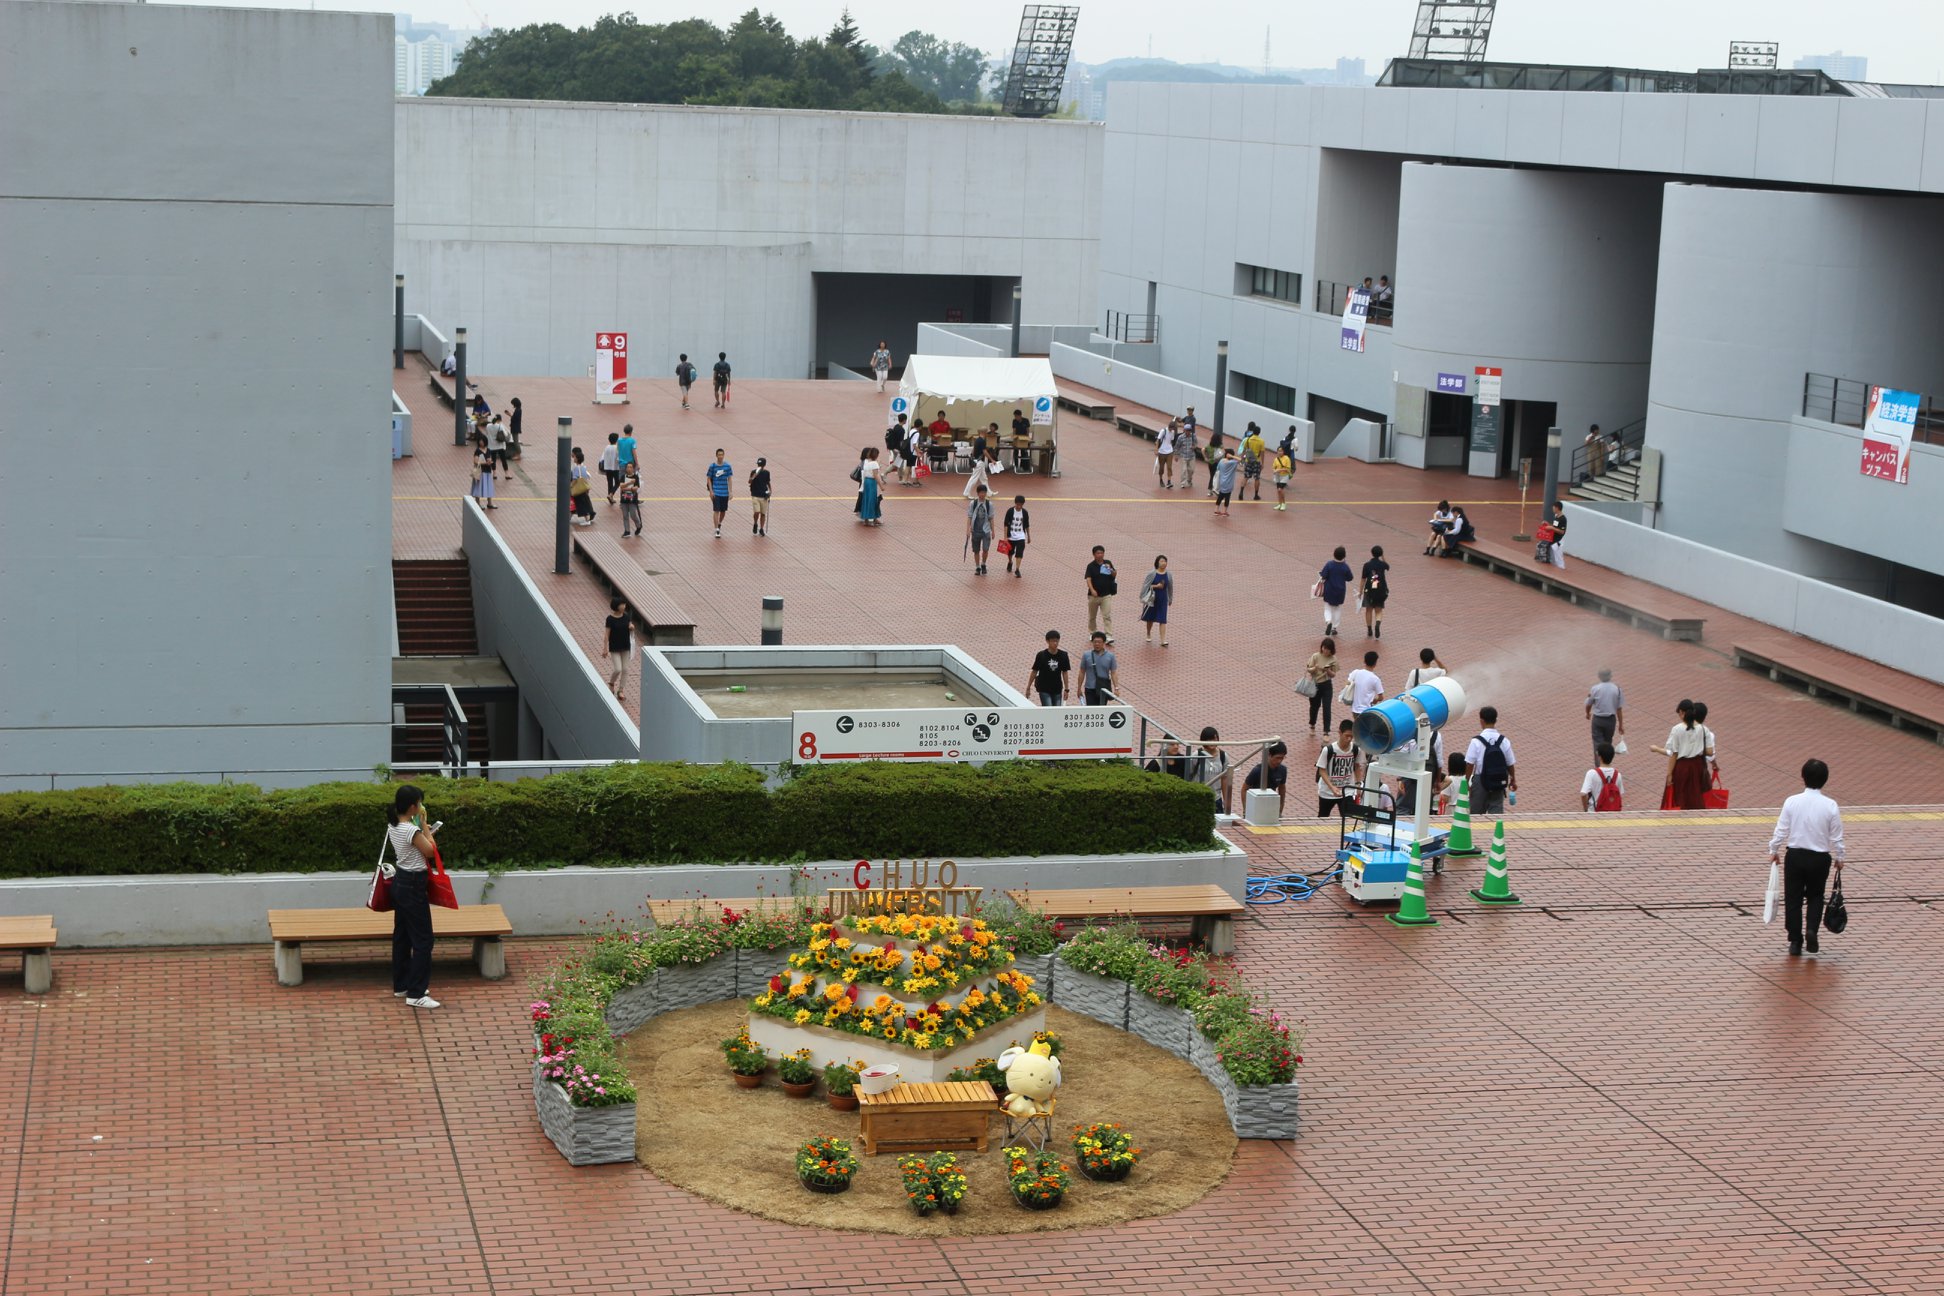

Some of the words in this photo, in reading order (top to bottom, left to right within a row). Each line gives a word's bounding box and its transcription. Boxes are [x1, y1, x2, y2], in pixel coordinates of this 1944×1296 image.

[614, 335, 625, 350] 9
[1440, 377, 1463, 388] 法学部
[1881, 401, 1918, 423] 経済学部
[1862, 447, 1897, 465] キャンパス
[1866, 464, 1890, 477] ツアー
[798, 732, 817, 759] 8
[853, 860, 958, 890] CHUO
[828, 890, 983, 921] UNIVERSITY
